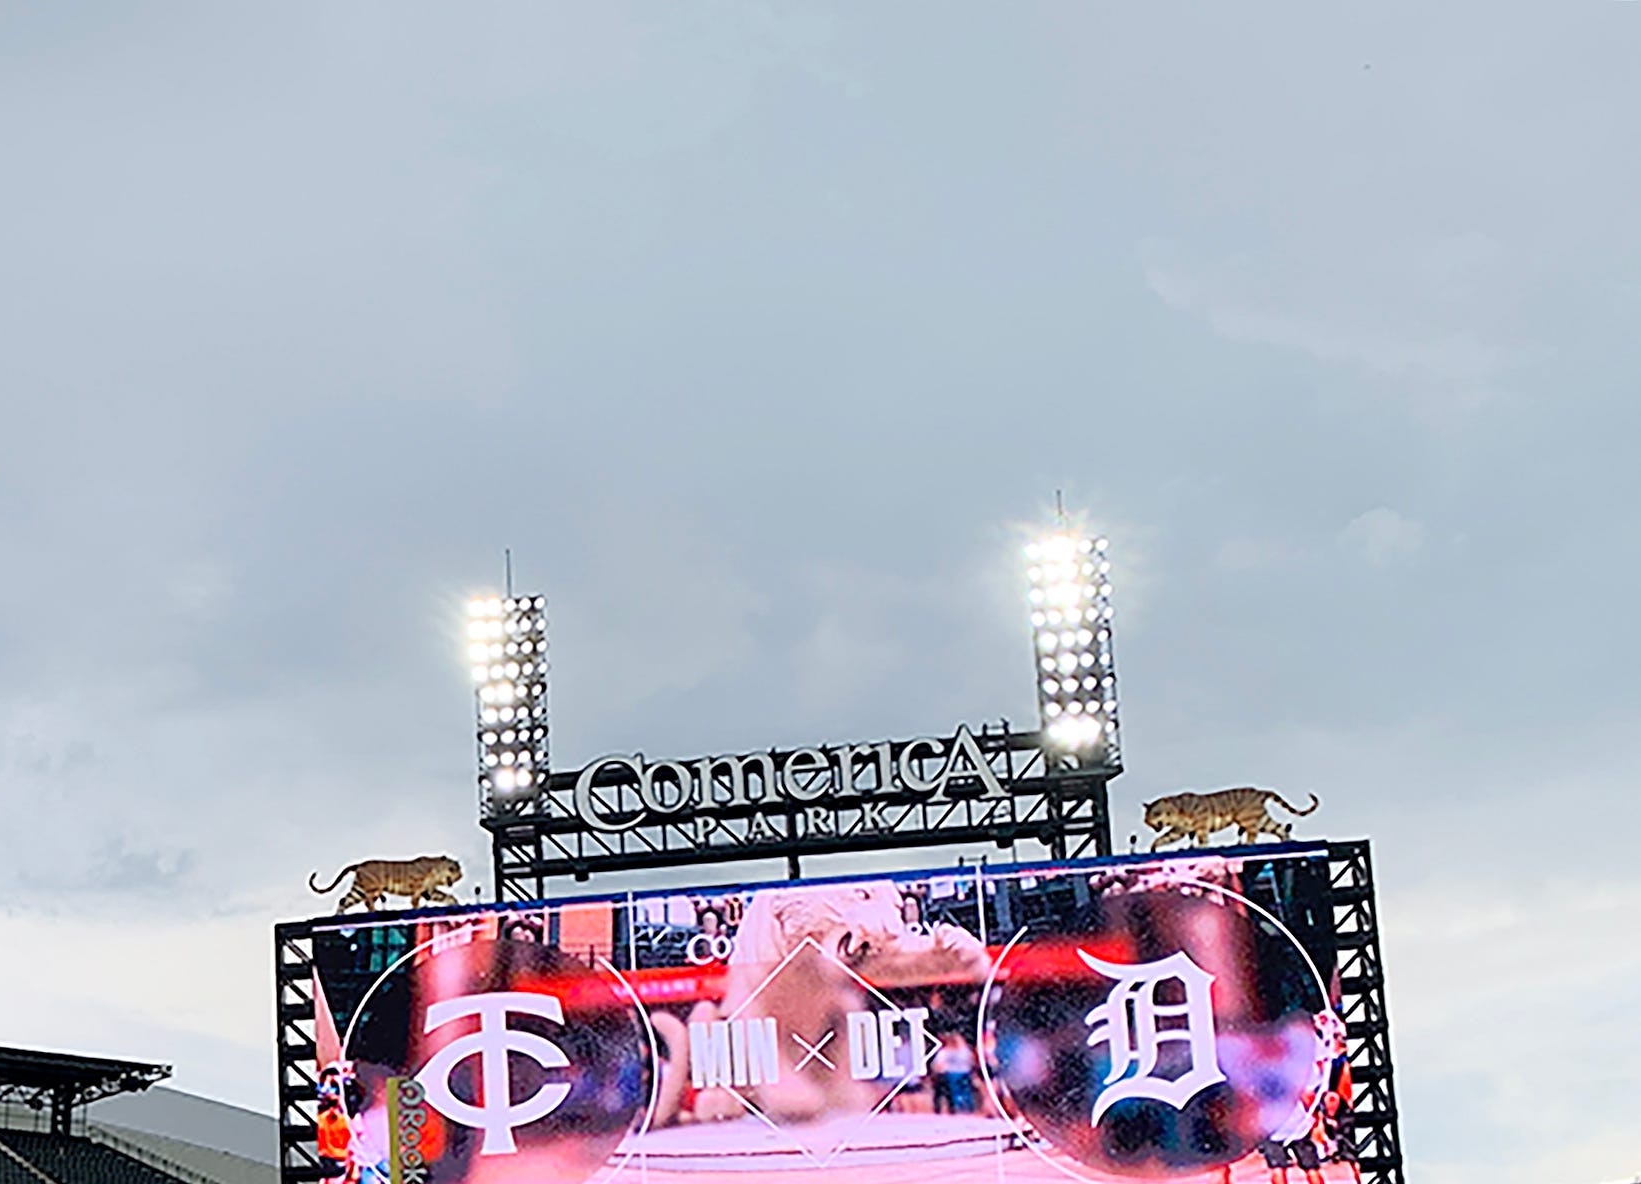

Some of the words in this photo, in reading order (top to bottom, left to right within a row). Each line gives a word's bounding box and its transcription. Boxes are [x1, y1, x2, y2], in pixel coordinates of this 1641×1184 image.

[695, 802, 888, 845] PARK
[689, 1017, 779, 1089] MIN
[847, 1007, 929, 1083] DET
